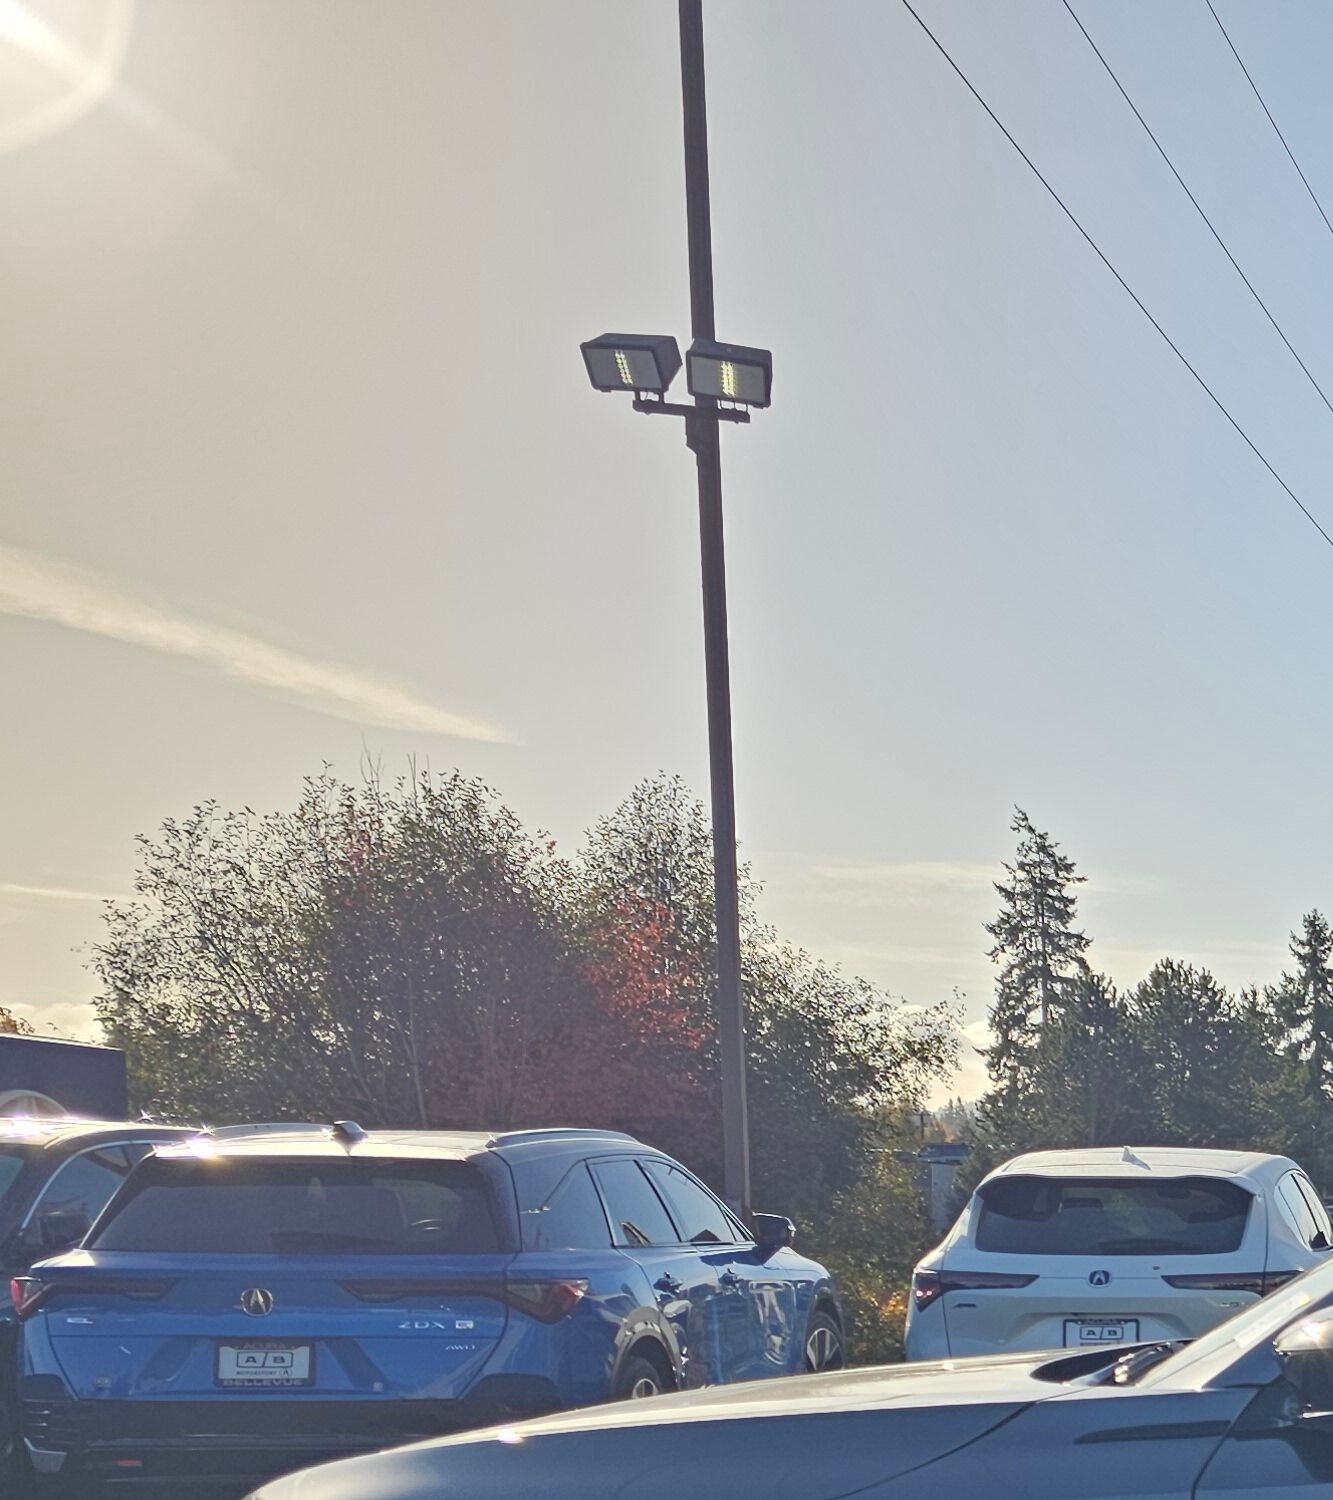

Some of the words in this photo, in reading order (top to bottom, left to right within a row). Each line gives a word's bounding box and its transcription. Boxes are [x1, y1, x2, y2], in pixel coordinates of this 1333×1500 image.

[398, 1321, 446, 1330] ZDX
[1084, 1326, 1120, 1340] A/B
[242, 1352, 289, 1368] A/B
[223, 1379, 303, 1387] BELLEVUE
